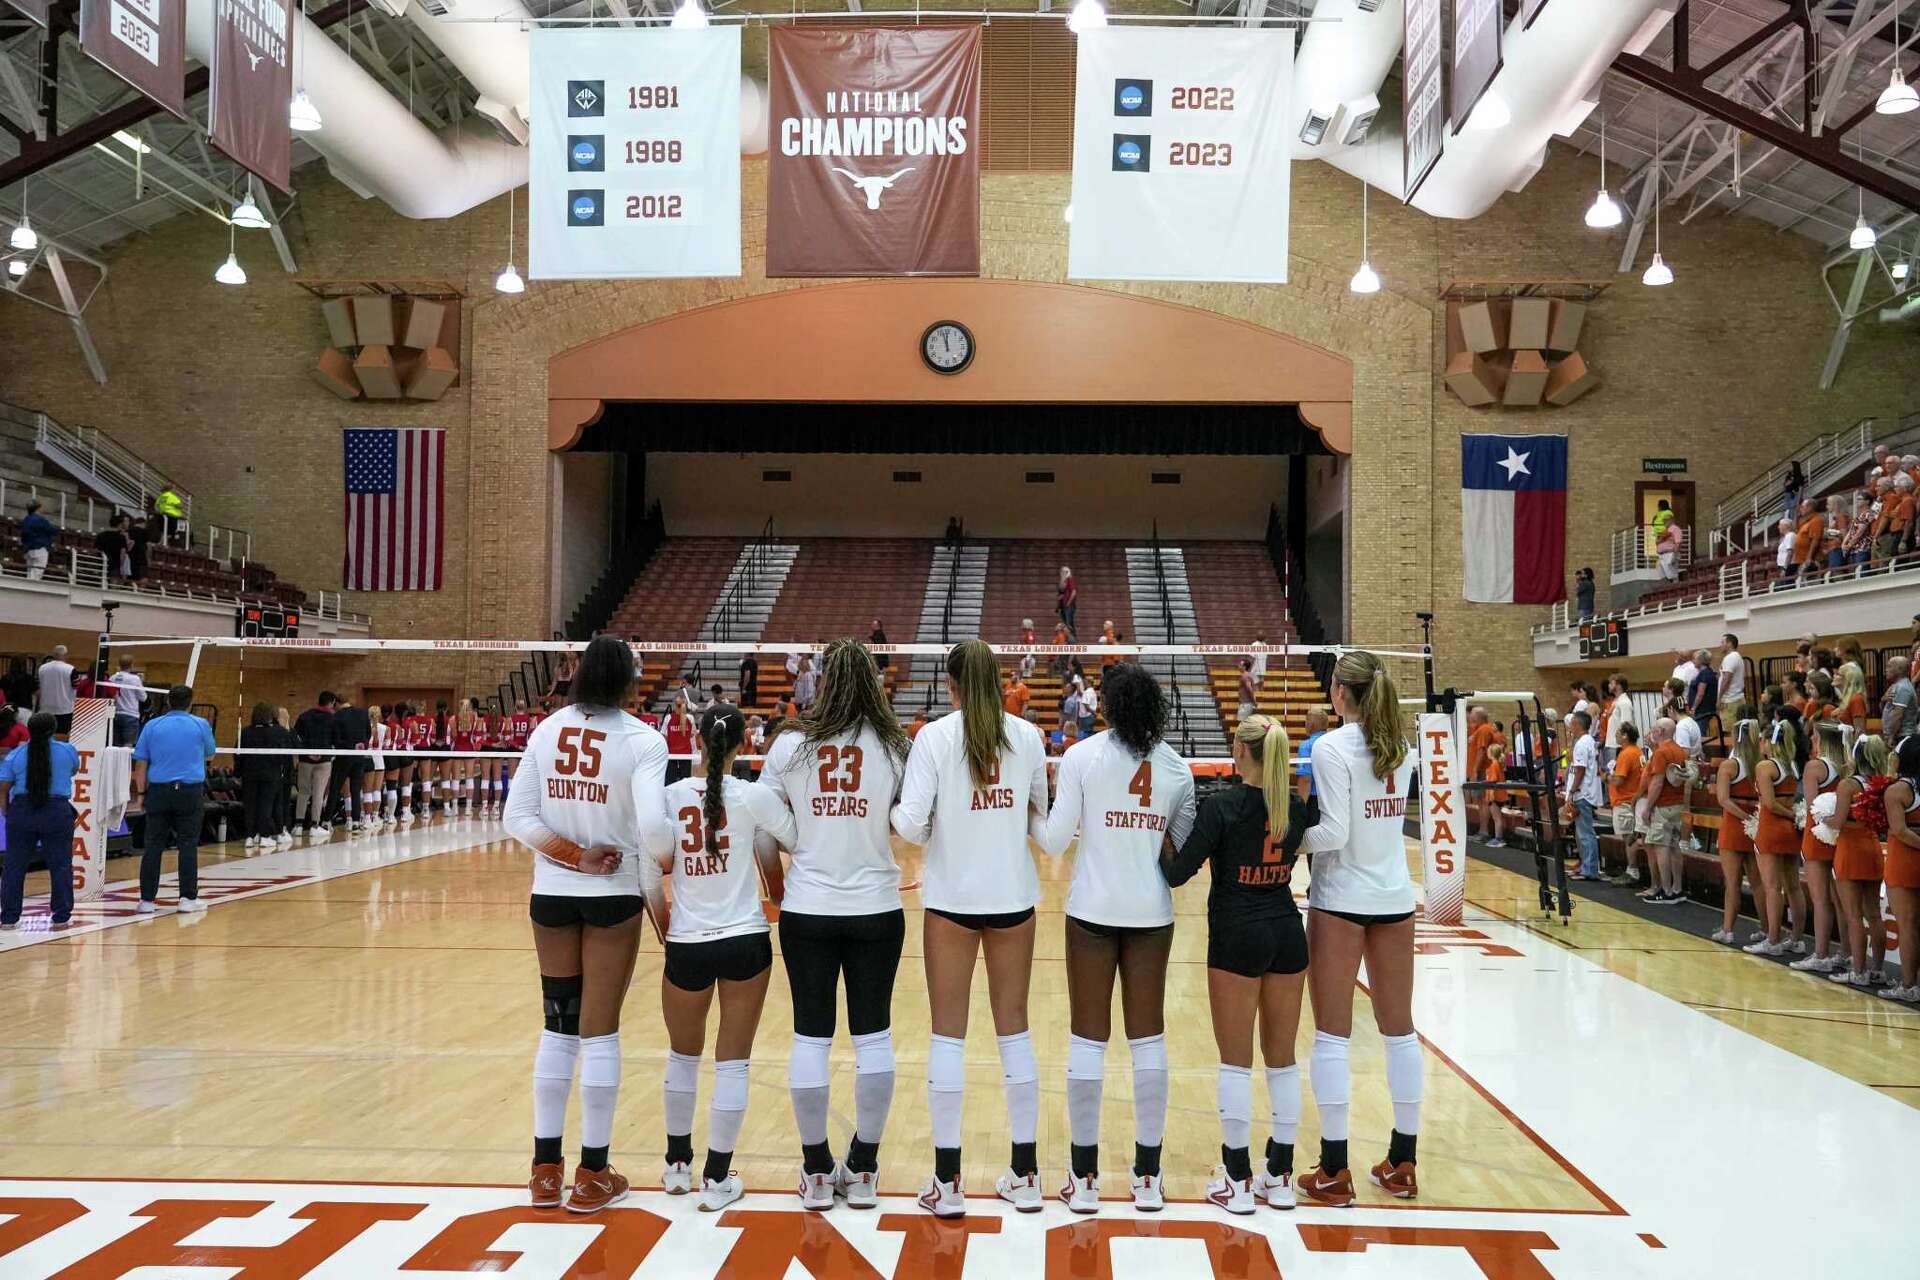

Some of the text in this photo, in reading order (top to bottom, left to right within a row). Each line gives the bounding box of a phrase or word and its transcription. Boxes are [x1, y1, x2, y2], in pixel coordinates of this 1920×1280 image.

[120, 15, 150, 53] 2023
[628, 86, 679, 109] 1981
[826, 92, 922, 113] NATIONAL
[1171, 87, 1234, 110] 2022
[781, 117, 967, 156] CHAMPIONS
[574, 152, 595, 160] NCAA
[625, 140, 682, 163] 1988
[1169, 142, 1232, 166] 2023
[626, 195, 682, 218] 2012
[1644, 461, 1685, 470] Restrooms
[433, 641, 464, 649] TEXAS
[419, 723, 427, 734] 5
[515, 721, 528, 732] 18
[555, 727, 608, 778] 55
[817, 744, 863, 792] 23
[547, 778, 609, 804] BUNTON
[1129, 760, 1153, 807] 4
[971, 788, 1014, 810] AMES
[1425, 730, 1457, 874] TEXAS
[71, 750, 95, 890] TEXAS
[678, 805, 729, 853] 32
[1105, 811, 1167, 832] STAFFORD
[684, 853, 729, 876] GARY
